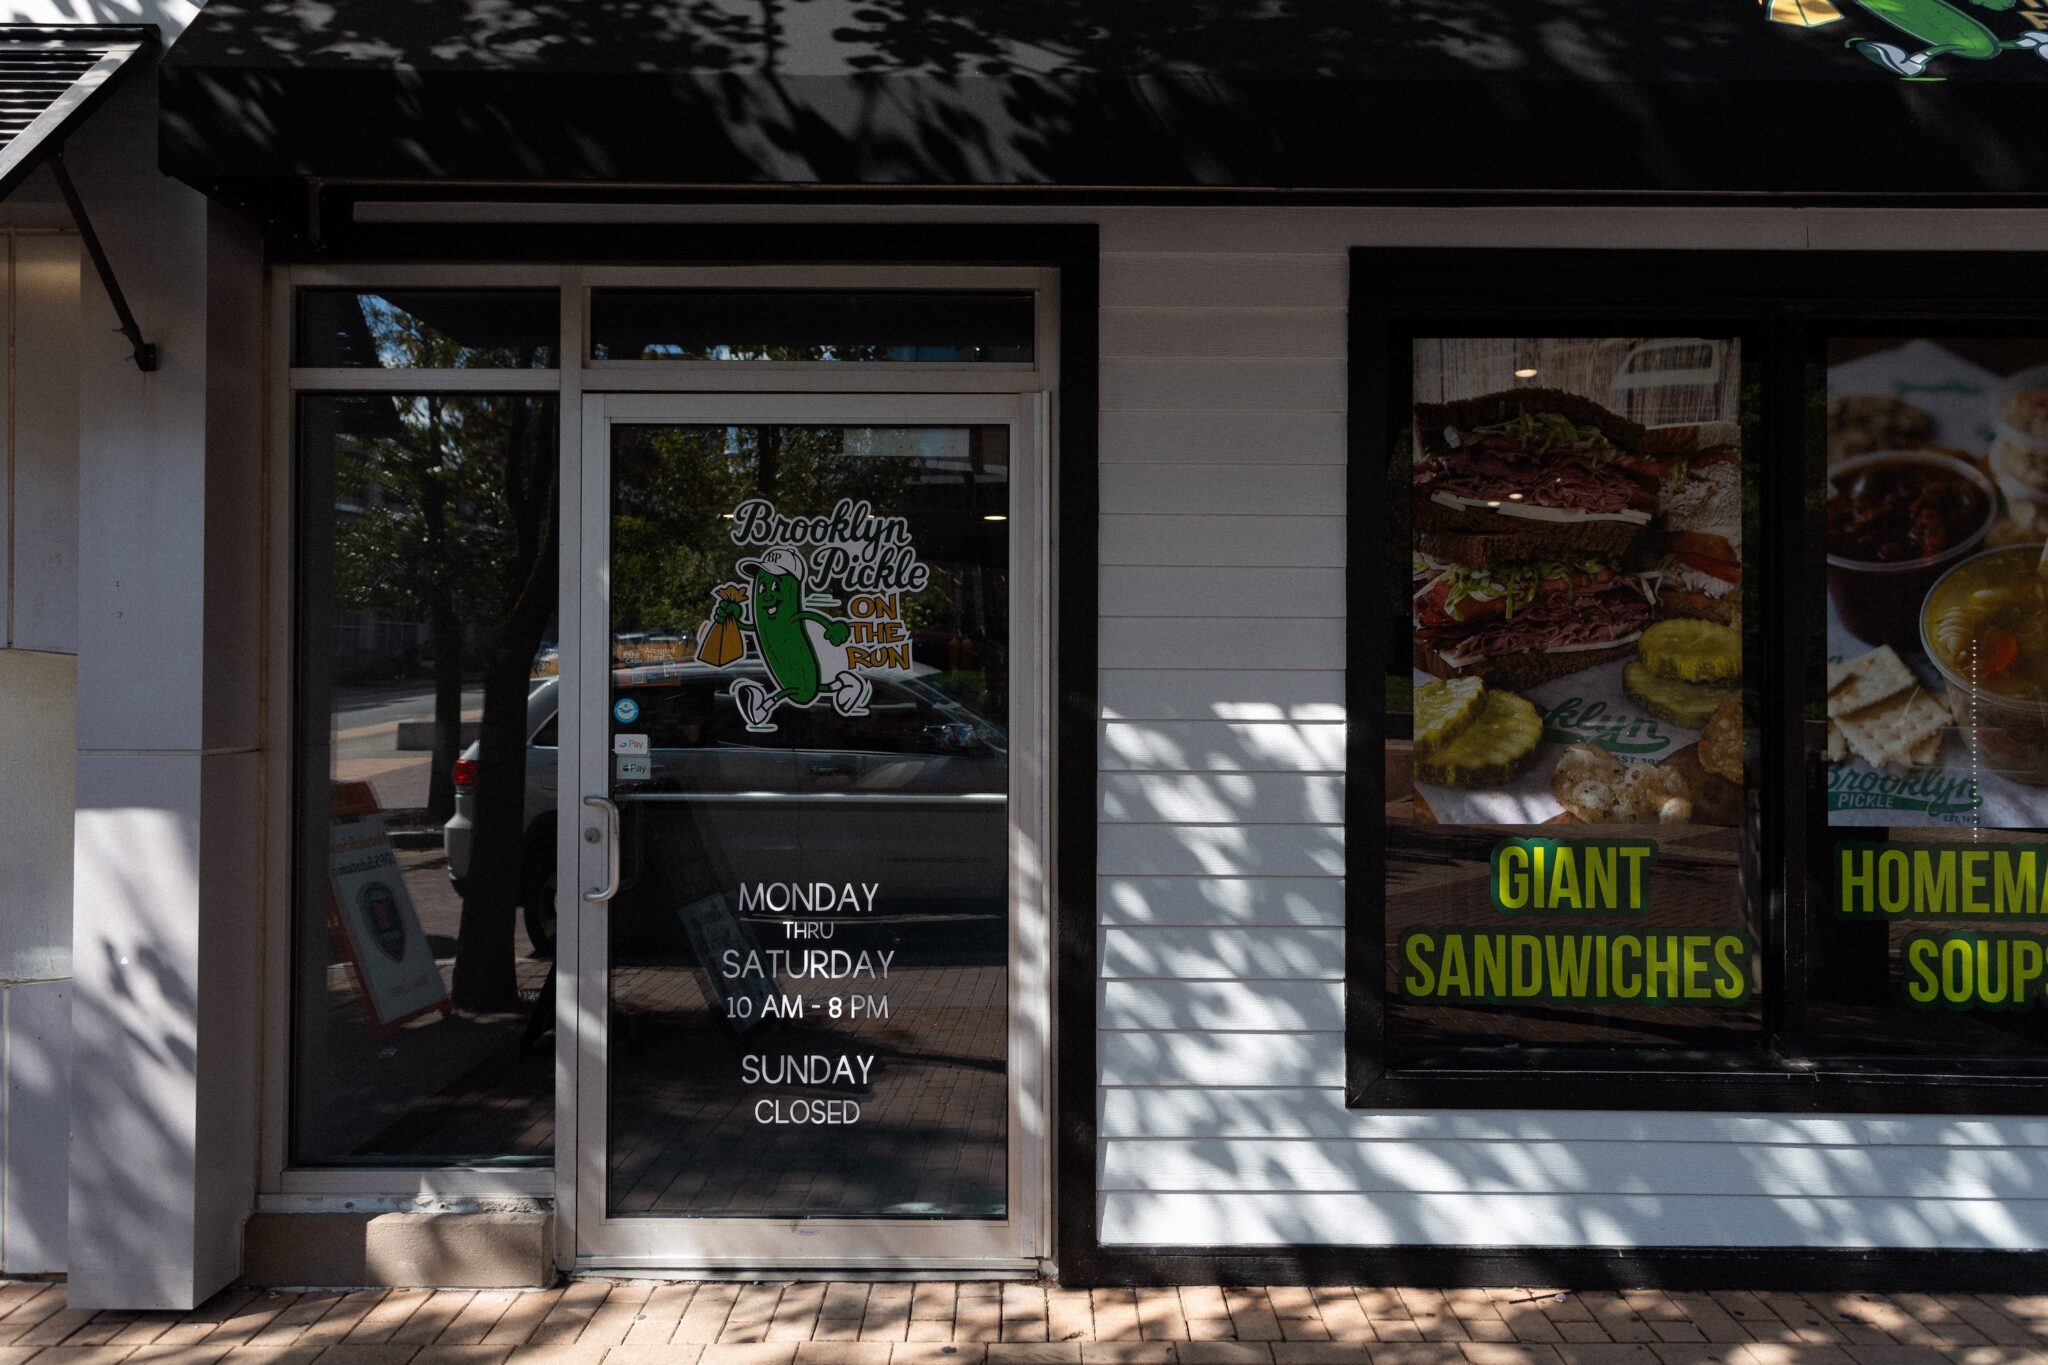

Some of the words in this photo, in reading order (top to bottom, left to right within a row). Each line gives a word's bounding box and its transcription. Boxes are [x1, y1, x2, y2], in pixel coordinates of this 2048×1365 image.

[733, 499, 911, 562] Brooklyn
[767, 552, 782, 563] BP
[812, 547, 928, 590] Pickle
[850, 594, 898, 620] ON
[850, 622, 904, 644] THE
[847, 644, 911, 670] RUN
[629, 739, 644, 749] Pay
[630, 764, 647, 774] Pay
[1838, 793, 1895, 808] PICKLE
[1499, 846, 1651, 910] GIANT
[738, 882, 879, 912] MONDAY
[783, 921, 834, 939] THRU
[722, 950, 895, 979] SATURDAY
[1405, 934, 1745, 998] SANDWICHES
[1908, 938, 2048, 1003] SOUP
[727, 996, 752, 1019] 10
[760, 995, 804, 1019] AM
[828, 996, 843, 1019] 8
[850, 995, 889, 1019] PM
[741, 1055, 874, 1084] SUNDAY
[754, 1099, 860, 1125] CLOSED
